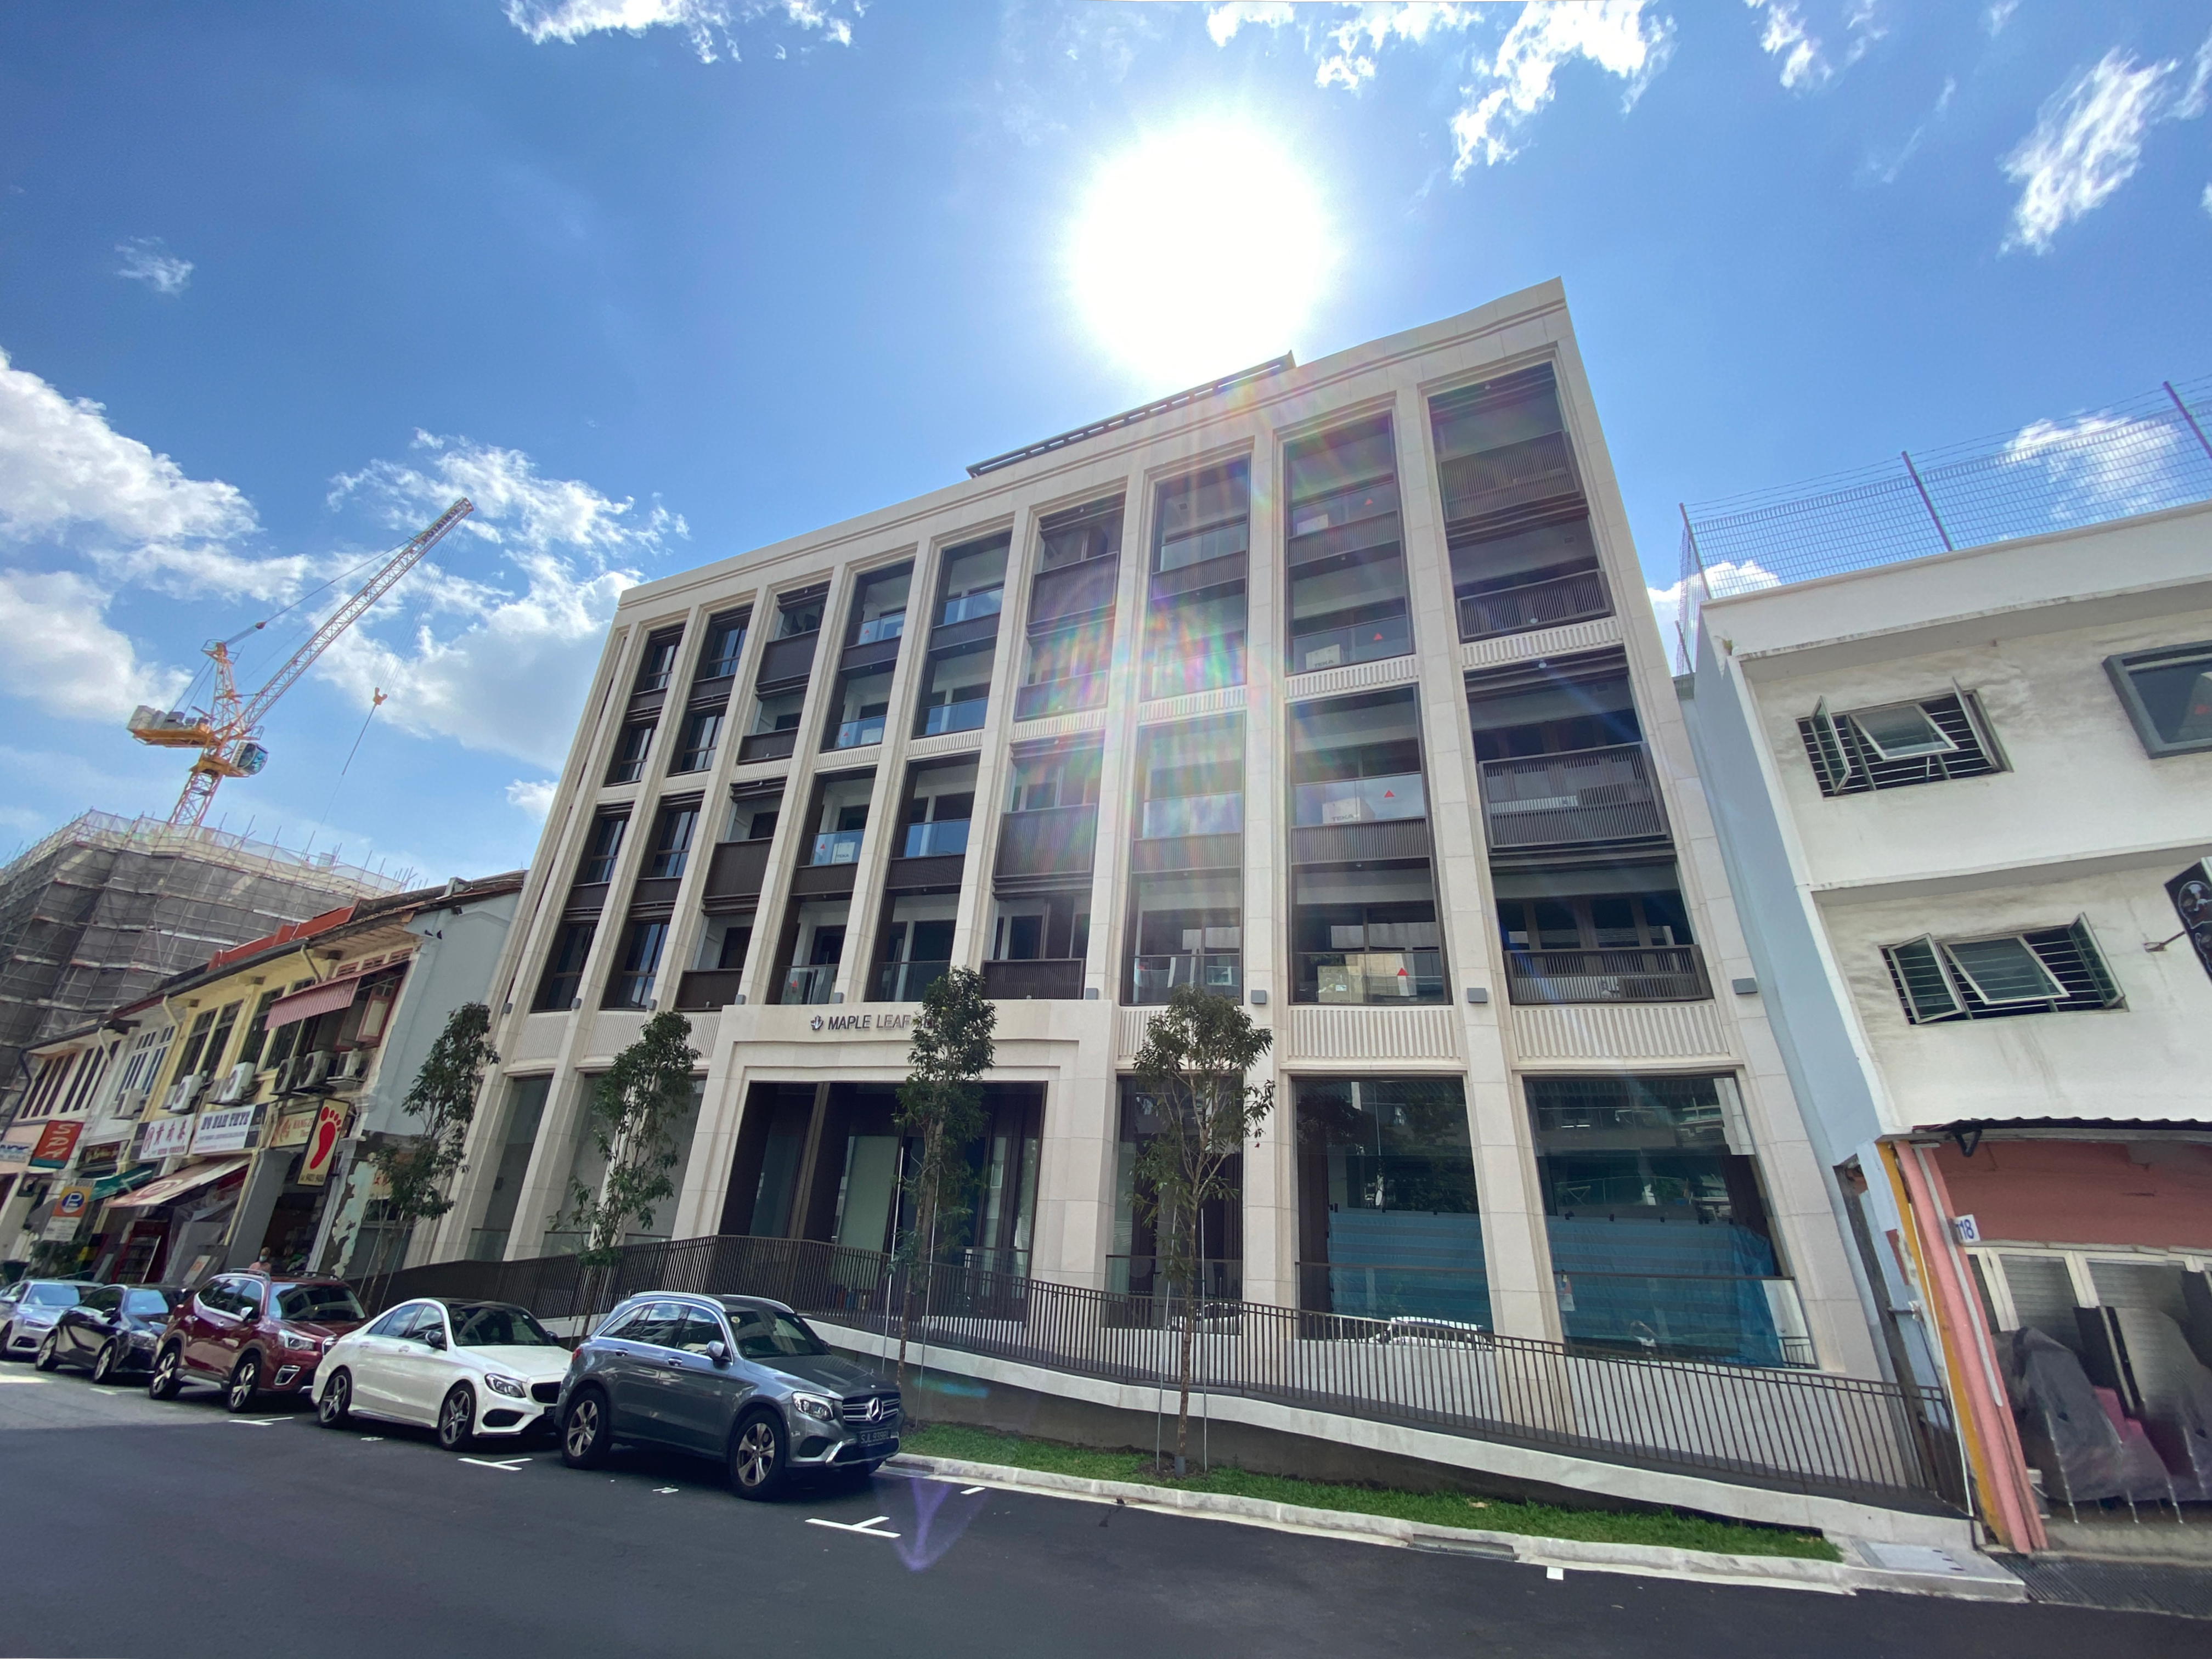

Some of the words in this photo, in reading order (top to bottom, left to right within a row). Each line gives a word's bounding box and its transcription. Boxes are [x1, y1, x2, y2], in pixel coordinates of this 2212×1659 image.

[1330, 814, 1354, 822] TEKA
[828, 1015, 871, 1030] MAPLE
[876, 1014, 911, 1029] LEAF
[38, 1123, 76, 1159] SPA
